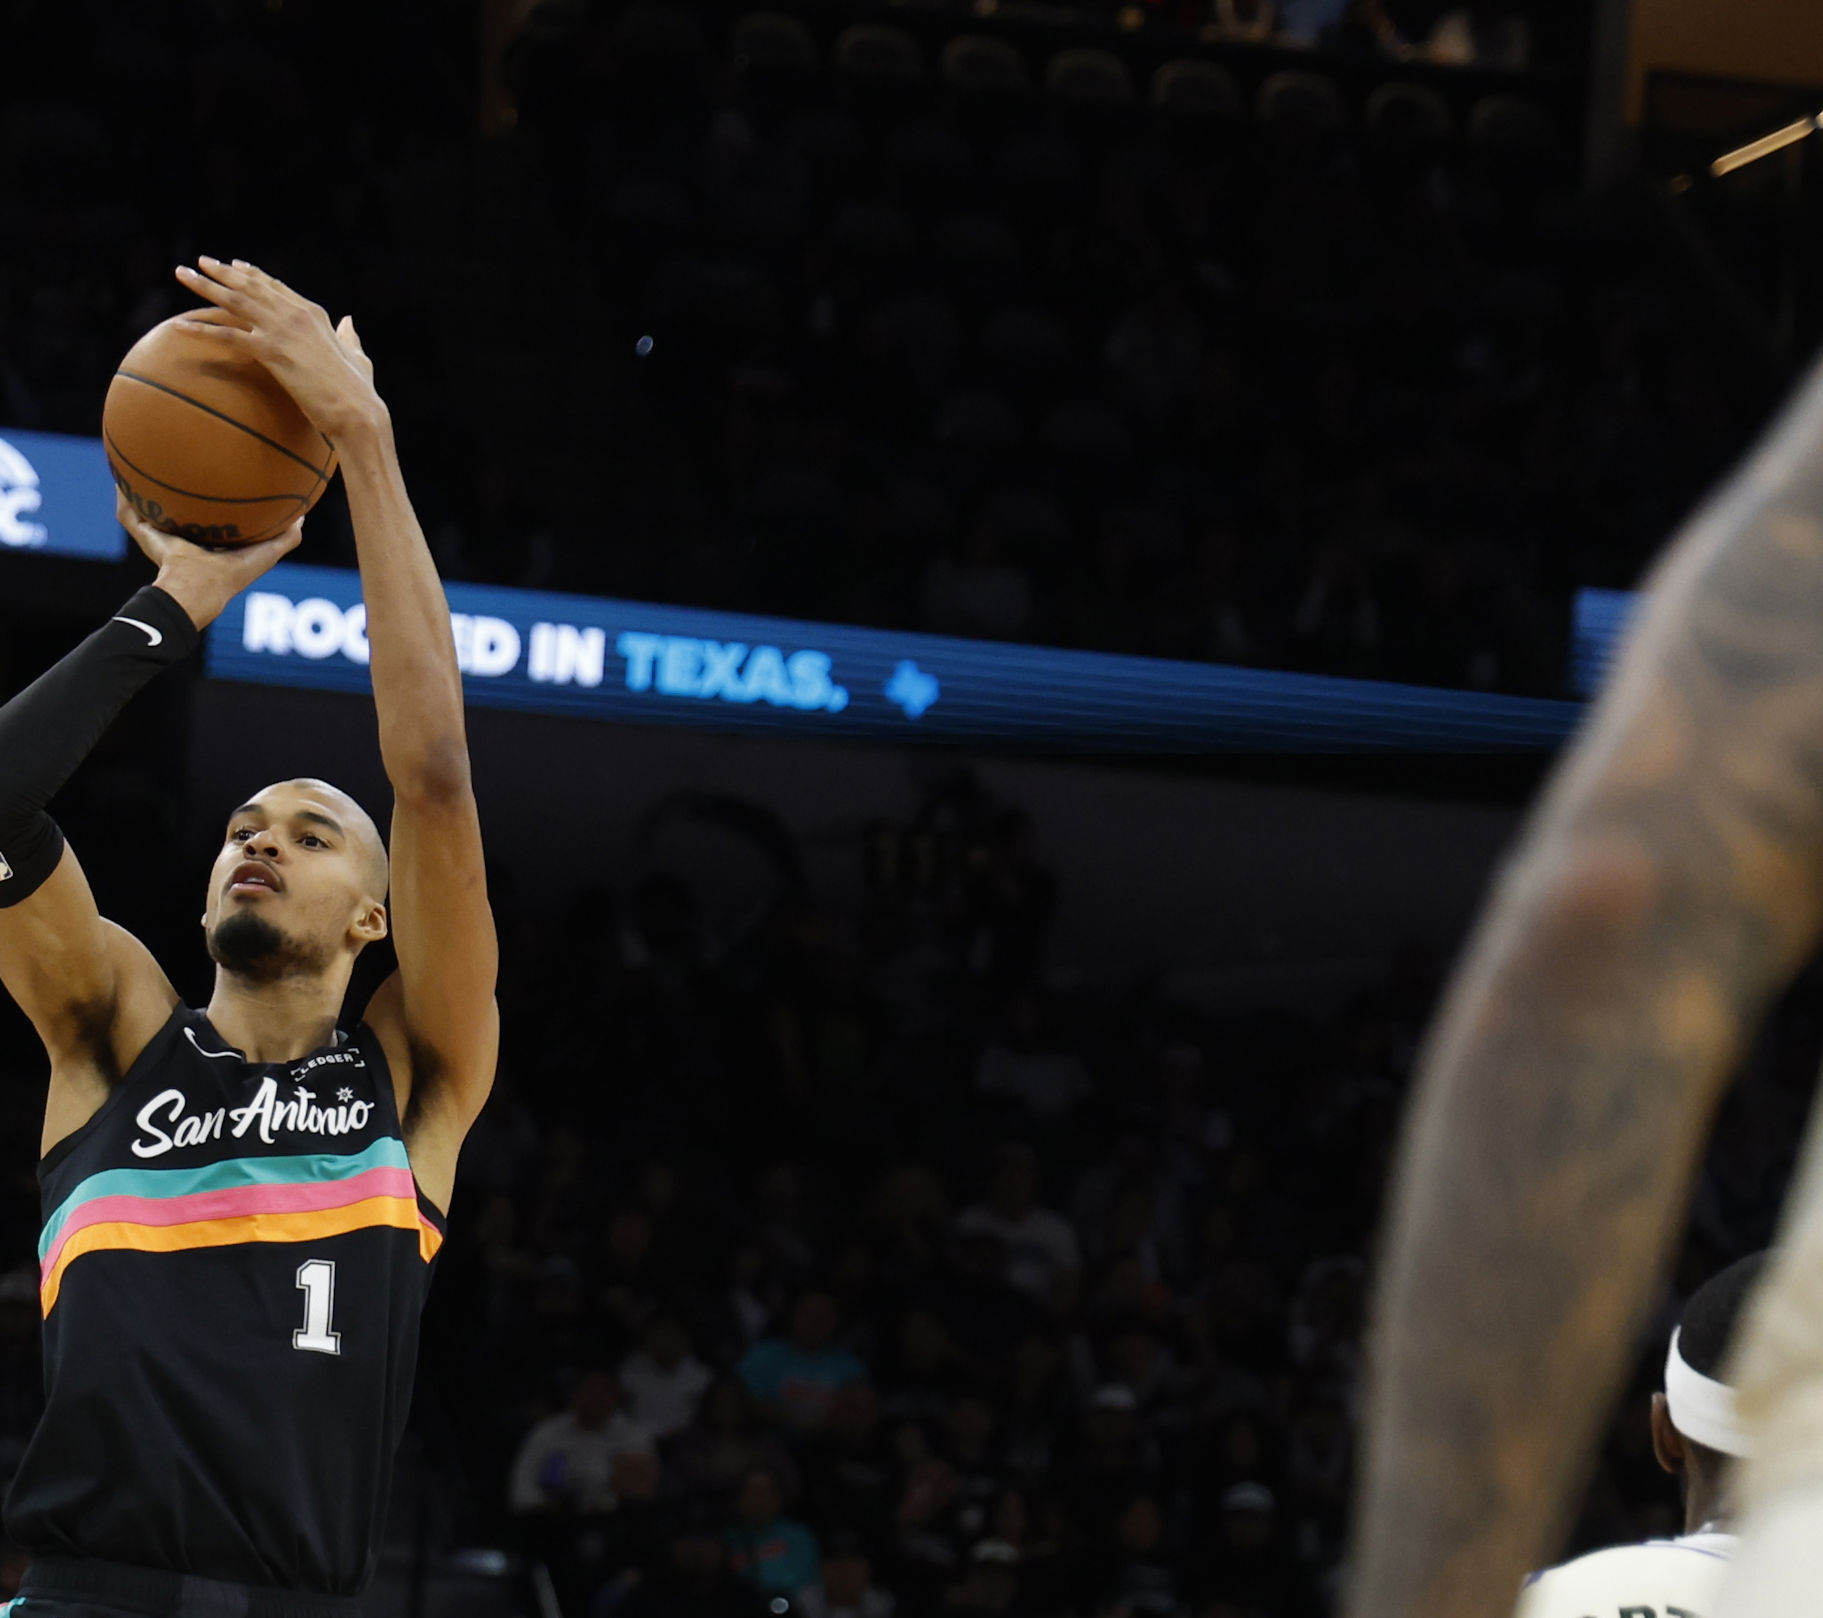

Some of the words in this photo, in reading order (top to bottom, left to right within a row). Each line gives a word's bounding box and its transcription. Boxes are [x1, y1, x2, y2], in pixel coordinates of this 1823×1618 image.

[527, 622, 606, 687] IN
[616, 631, 850, 714] TEXAS.
[300, 1052, 354, 1075] LEDGER
[131, 1088, 225, 1159] San
[229, 1076, 375, 1145] Antonio
[293, 1259, 341, 1355] 1
